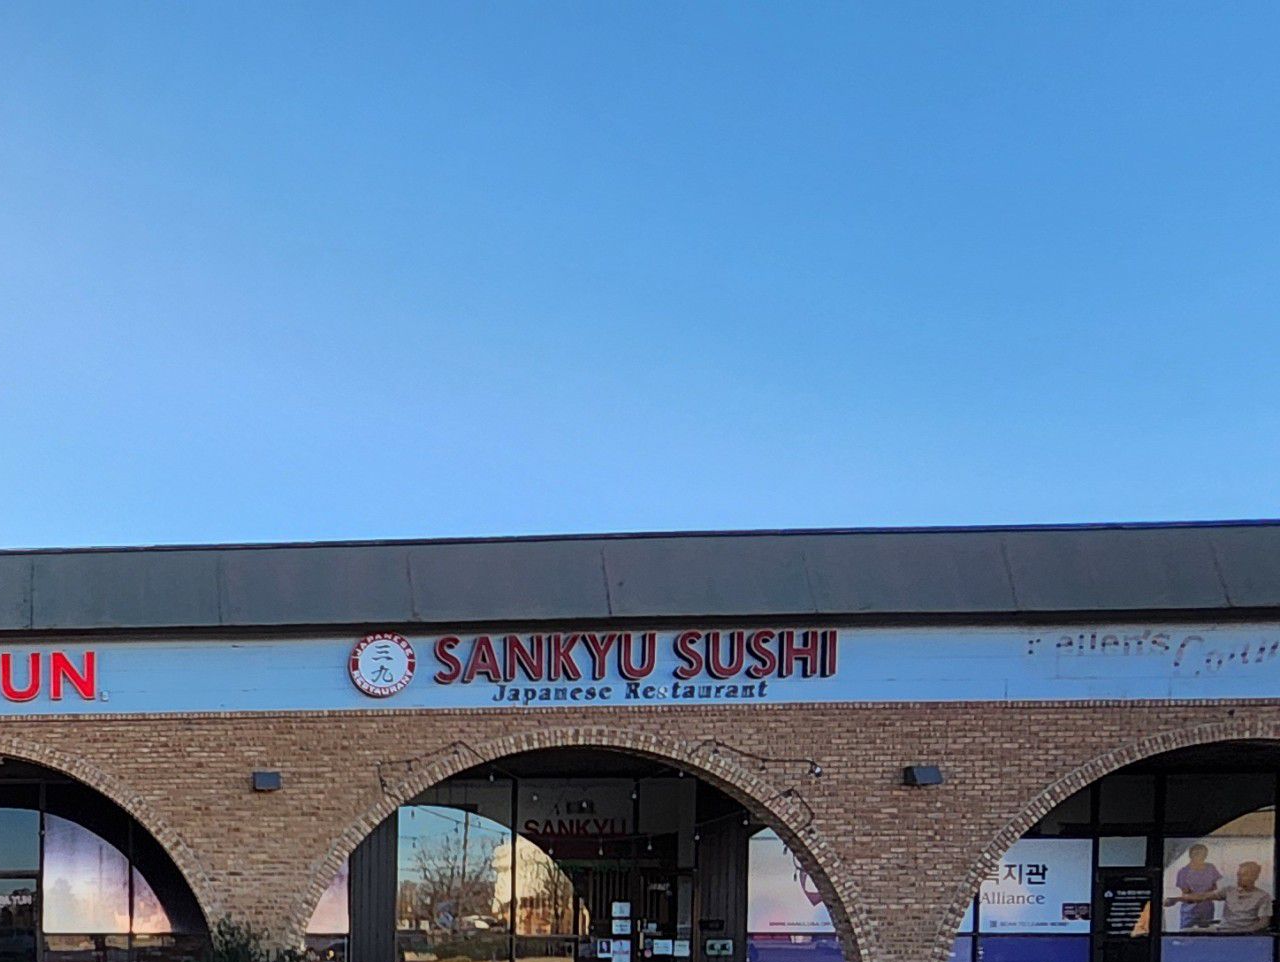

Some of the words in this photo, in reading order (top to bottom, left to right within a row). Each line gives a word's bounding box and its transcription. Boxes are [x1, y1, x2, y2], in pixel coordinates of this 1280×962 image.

[356, 632, 414, 656] JAPANESE
[434, 630, 657, 684] SANKYU
[673, 628, 837, 680] SUSHI
[352, 670, 413, 696] RESTAURANT
[492, 684, 612, 705] Japanese
[624, 680, 768, 700] Restaurant
[981, 891, 1046, 905] Alliance
